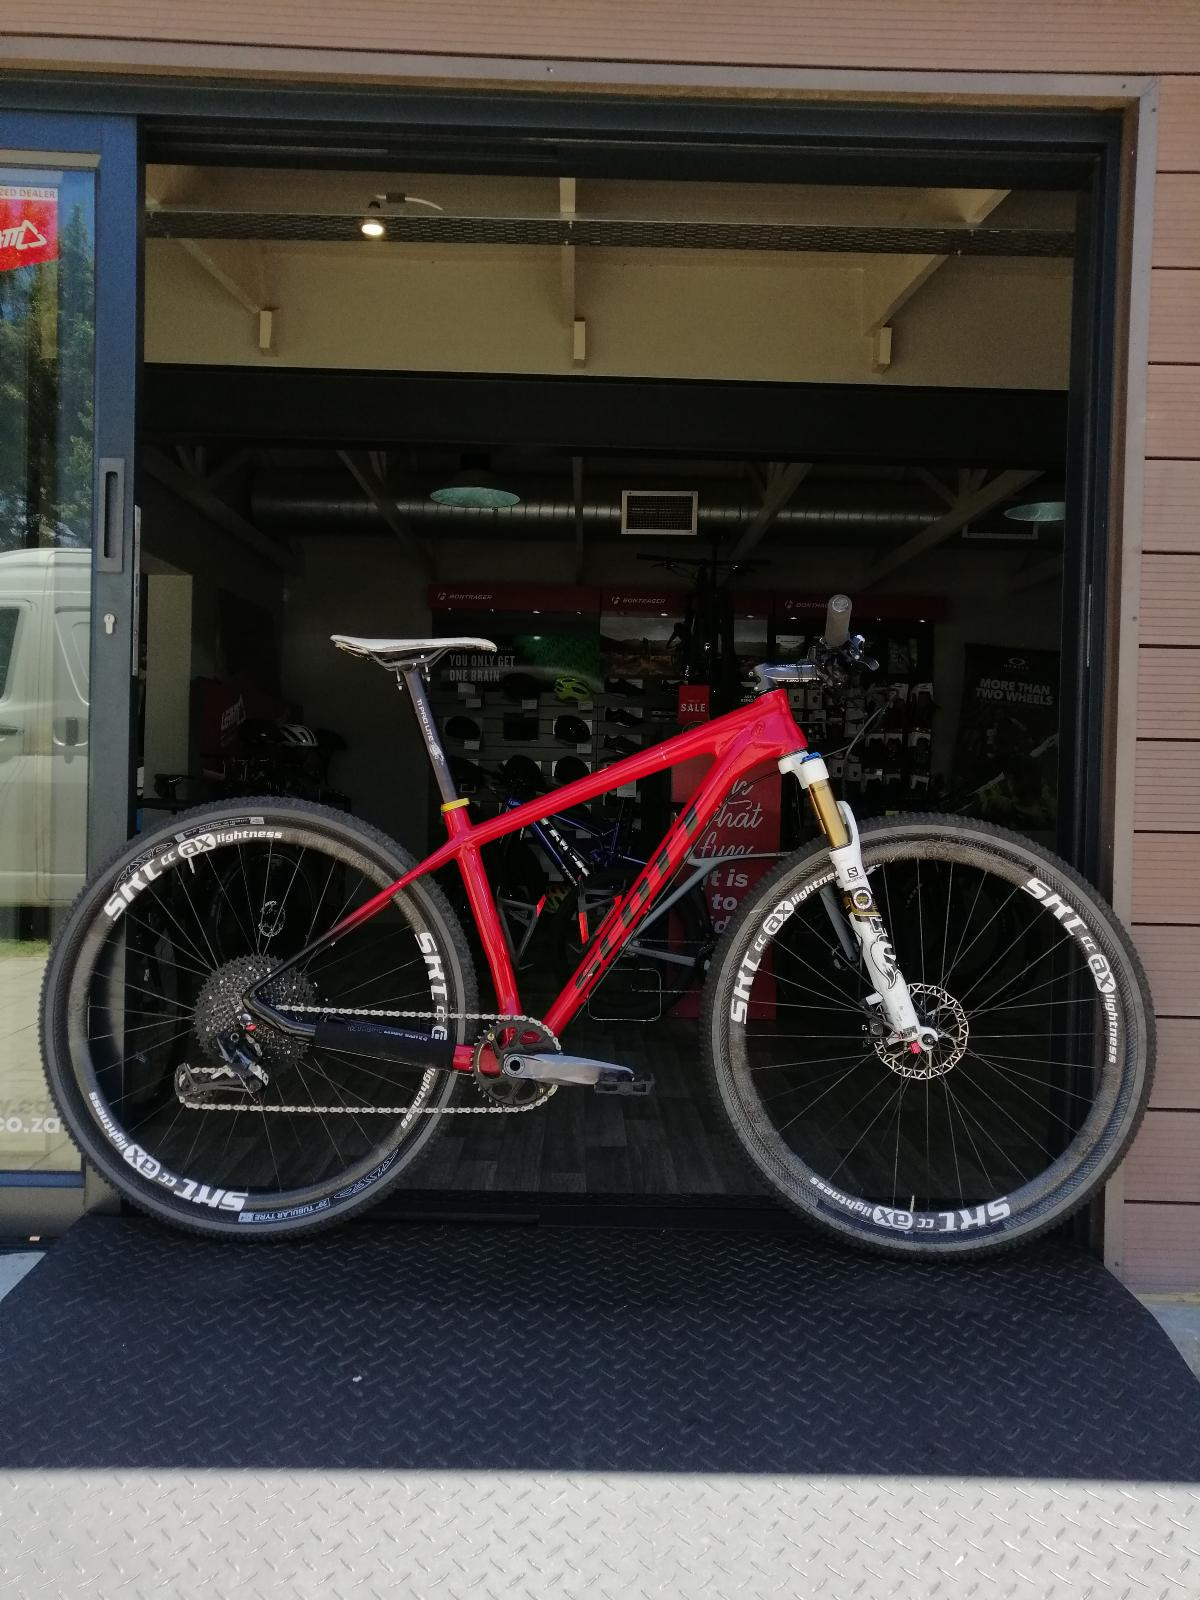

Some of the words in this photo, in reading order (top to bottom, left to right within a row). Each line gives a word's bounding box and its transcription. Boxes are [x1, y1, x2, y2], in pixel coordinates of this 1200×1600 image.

[19, 188, 56, 199] DEALER
[449, 655, 468, 667] YOU
[471, 655, 495, 667] ONLY
[497, 656, 516, 667] GET
[449, 669, 468, 682] ONE
[471, 669, 501, 682] BRAIN
[980, 678, 1016, 691] MORE
[1017, 681, 1051, 696] THAN
[976, 687, 1004, 700] TWO
[1005, 691, 1054, 706] WHEELS
[680, 703, 706, 712] SALE
[714, 802, 764, 829] hat
[216, 830, 283, 843] lightness
[727, 869, 749, 888] is
[712, 893, 738, 911] to
[1104, 993, 1118, 1064] lightness
[88, 1091, 129, 1151] lightness
[809, 1176, 873, 1218] lightness
[254, 1212, 277, 1222] TYRE
[276, 1205, 314, 1220] TUBULAR
